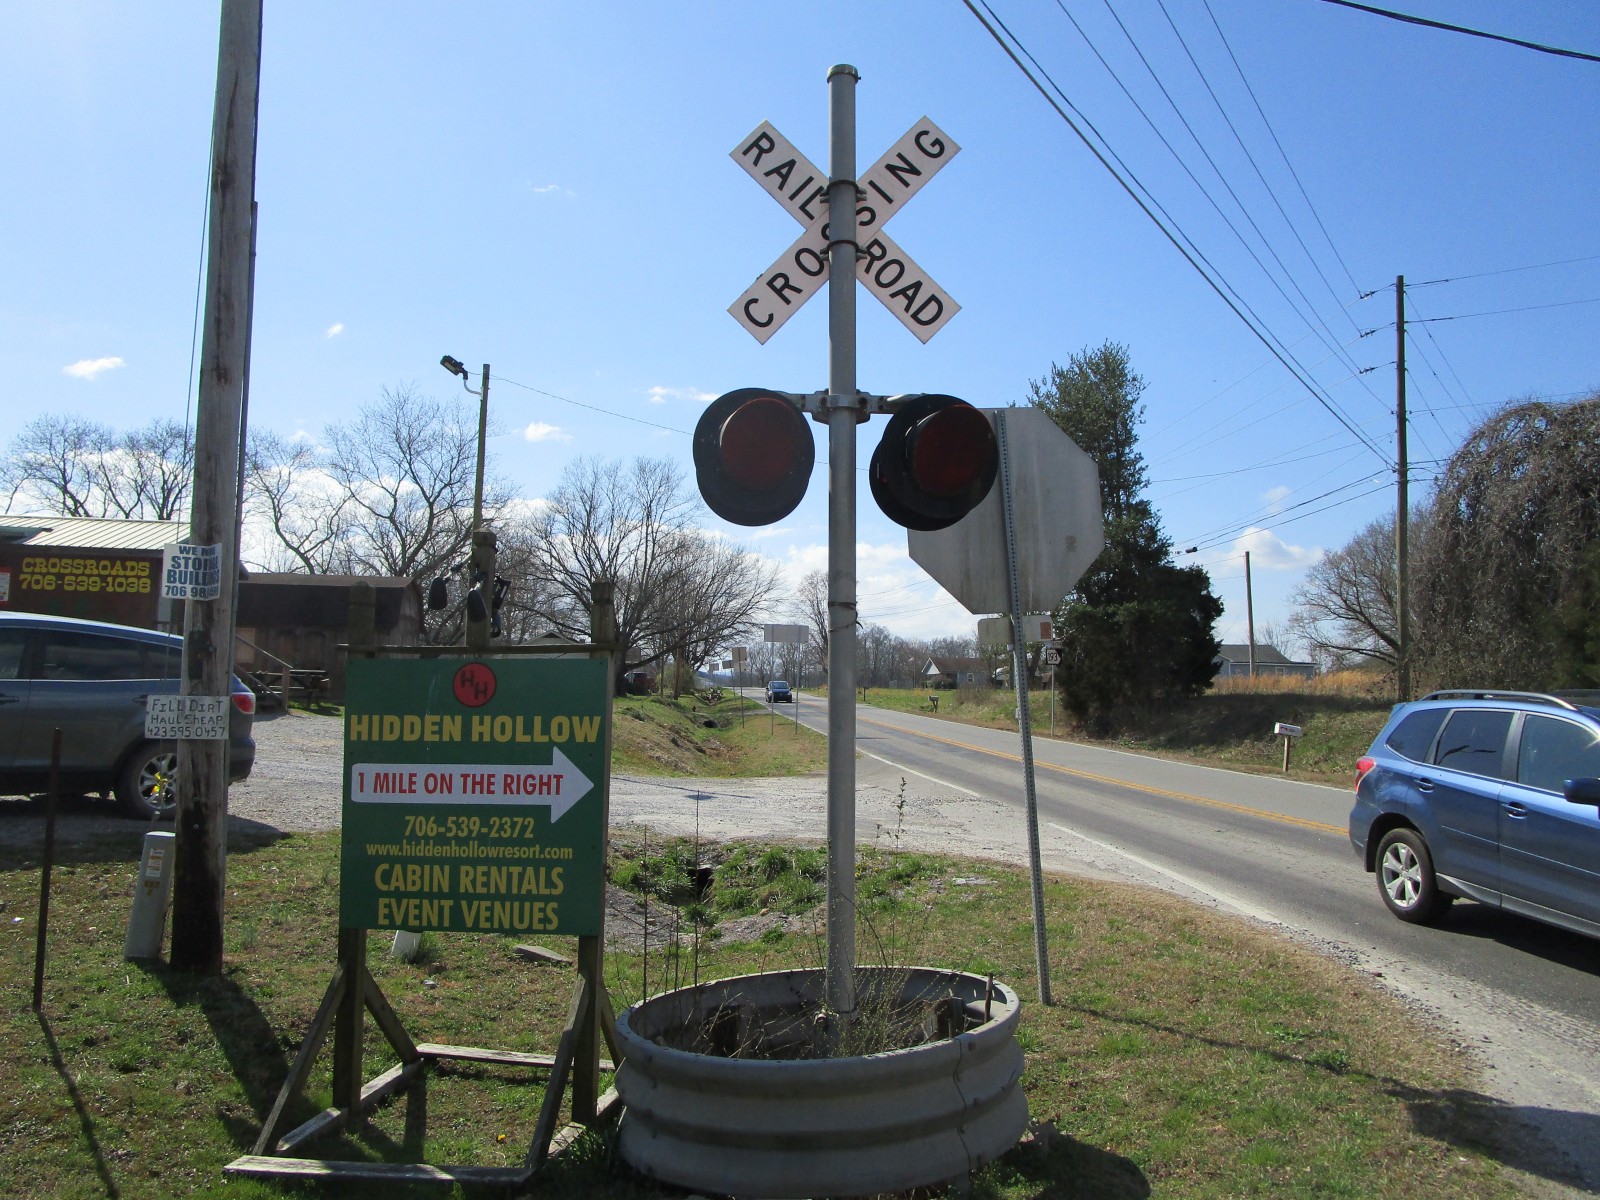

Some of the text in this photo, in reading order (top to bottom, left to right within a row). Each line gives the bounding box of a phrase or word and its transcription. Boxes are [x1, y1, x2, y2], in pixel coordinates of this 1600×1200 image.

[178, 545, 198, 556] WE
[22, 557, 151, 576] CROSSROADS
[19, 573, 151, 593] 706-539-1038
[165, 585, 187, 597] 706
[189, 699, 223, 713] DIRT
[350, 714, 601, 743] HIDDEN HOLLOW
[358, 772, 564, 796] 1 MILE ON THE RIGHT
[404, 815, 535, 838] 706-539-2372
[366, 840, 573, 859] www.hiddenhollowresort.com
[374, 863, 564, 895] CABIN RENTALS
[377, 898, 559, 931] EVENT VENUES
